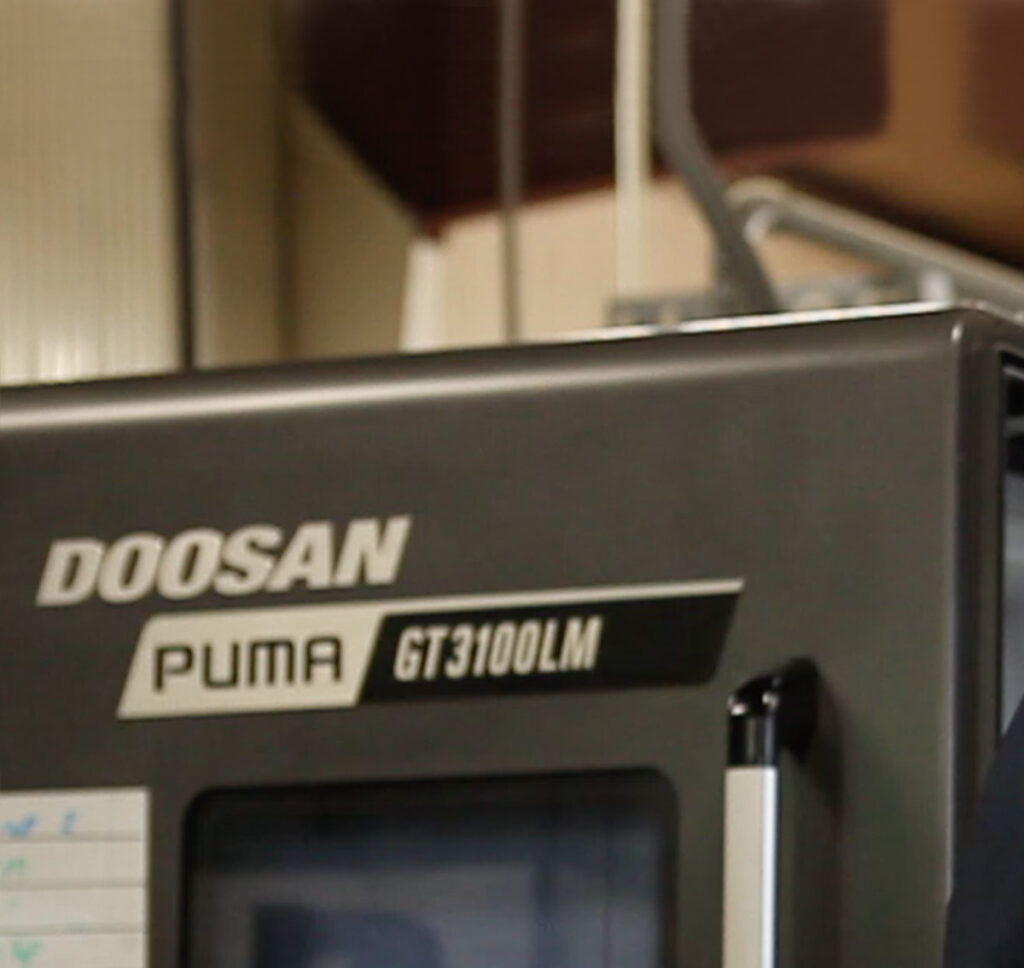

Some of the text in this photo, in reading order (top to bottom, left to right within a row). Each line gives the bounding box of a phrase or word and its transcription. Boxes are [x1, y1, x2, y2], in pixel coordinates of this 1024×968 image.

[35, 514, 412, 606] DOOSAN
[152, 615, 602, 694] PUMA GT3100LM
